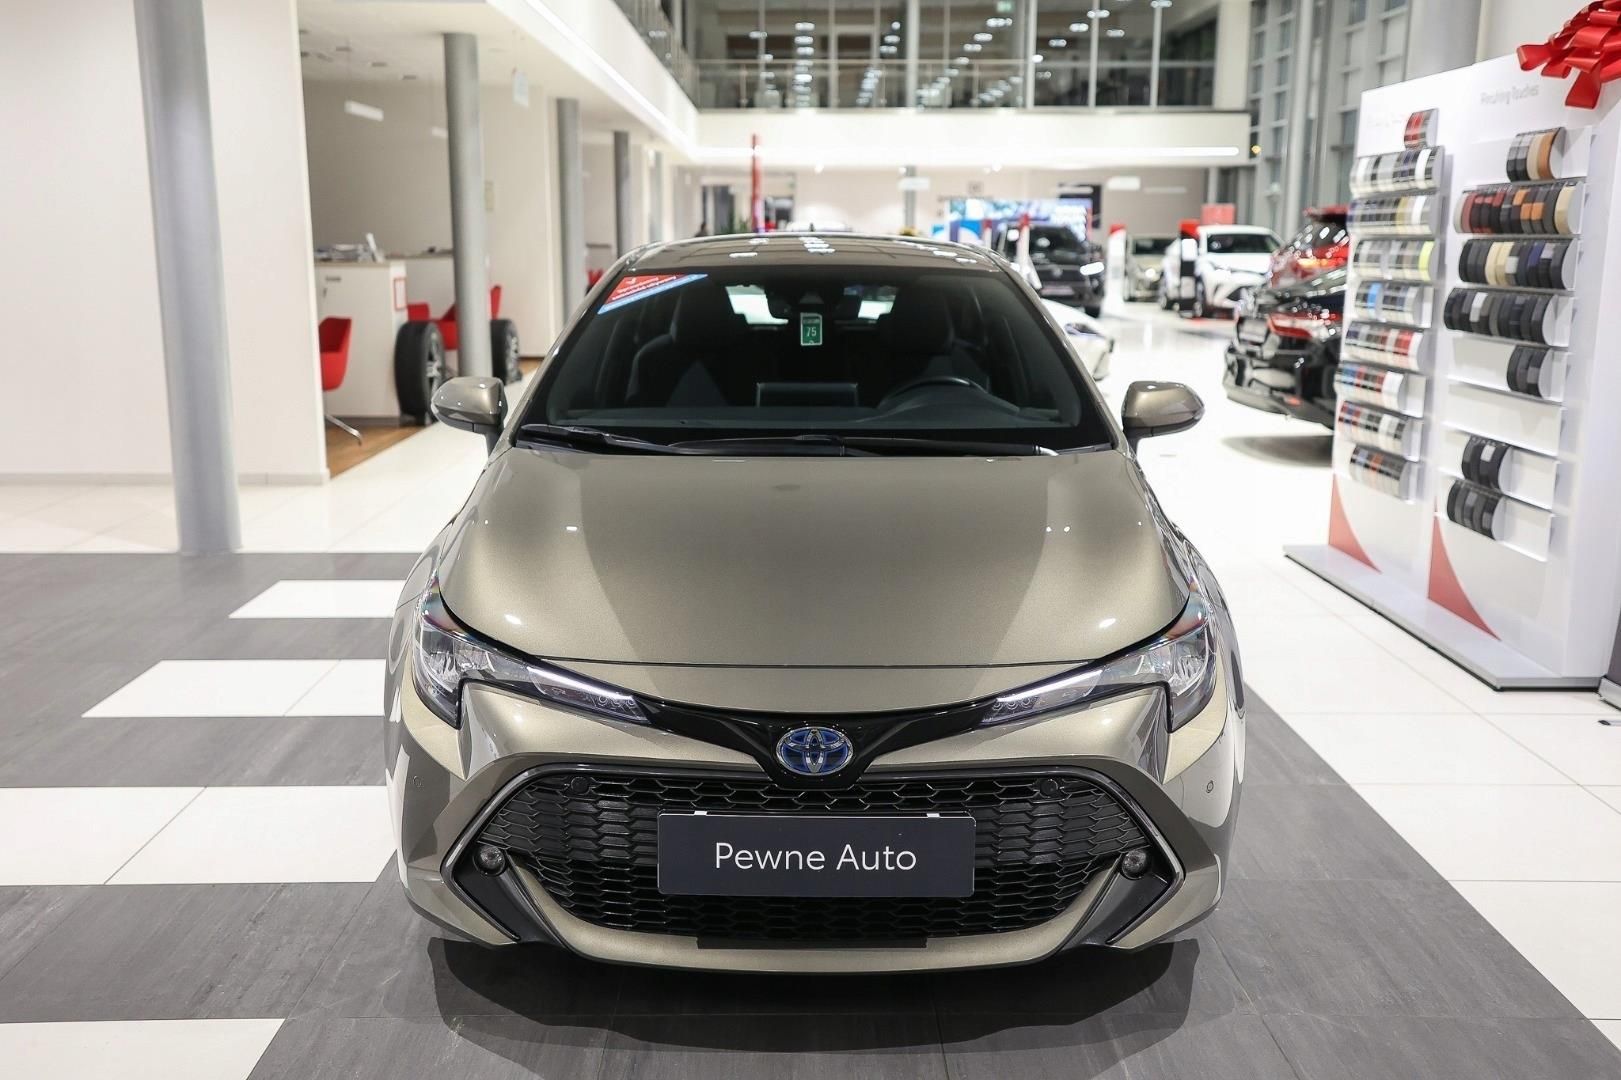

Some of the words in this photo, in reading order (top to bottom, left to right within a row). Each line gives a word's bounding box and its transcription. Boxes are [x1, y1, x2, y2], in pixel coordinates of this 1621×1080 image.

[805, 326, 817, 337] 75
[715, 842, 826, 870] Pewne
[836, 843, 917, 871] Auto
